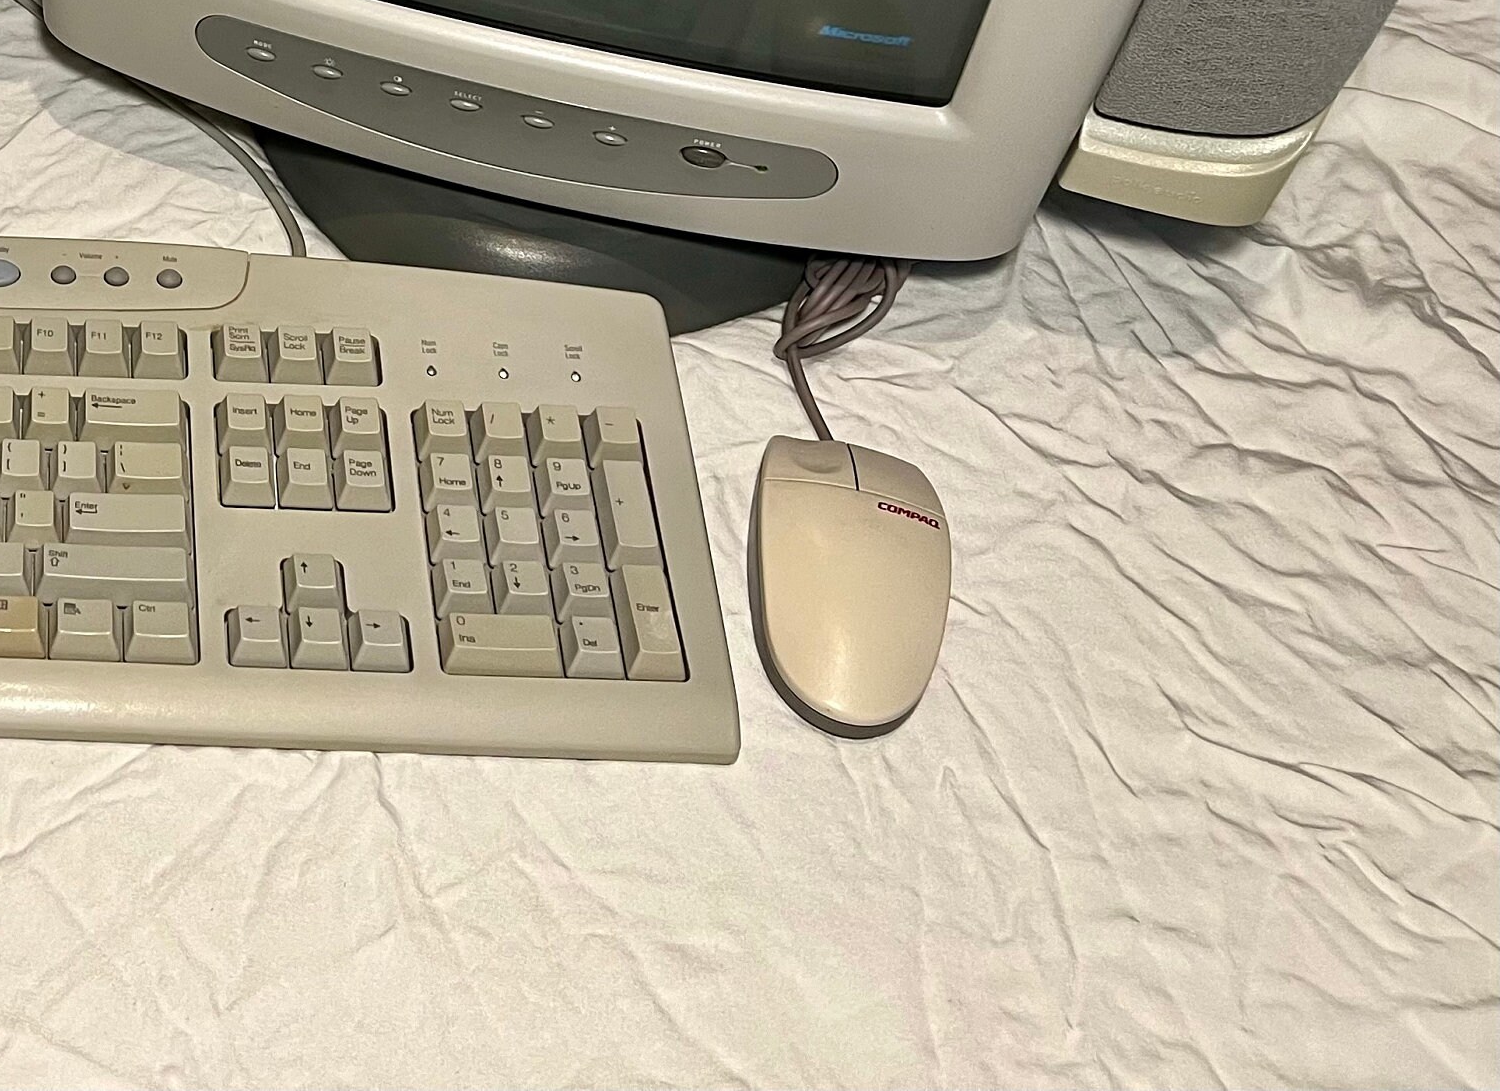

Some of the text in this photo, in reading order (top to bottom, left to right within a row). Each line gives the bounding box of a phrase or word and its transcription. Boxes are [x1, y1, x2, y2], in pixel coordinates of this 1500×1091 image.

[283, 333, 308, 341] Scroll
[338, 336, 366, 345] Pause
[284, 342, 305, 350] Lock
[339, 346, 365, 354] Break
[91, 394, 136, 405] Backspace
[232, 406, 257, 415] Insert
[290, 408, 317, 417] Home
[345, 406, 368, 416] Page
[432, 409, 453, 417] Num
[346, 416, 359, 425] Up
[432, 416, 455, 425] Lock
[293, 462, 311, 470] End
[349, 459, 372, 468] Page
[349, 468, 377, 477] Down
[439, 478, 467, 486] Home
[556, 481, 582, 491] PgUp
[74, 501, 98, 510] Enter
[877, 501, 941, 530] COMPAQ
[452, 580, 471, 588] End
[574, 583, 601, 593] PgDn
[138, 604, 156, 613] Ctrl
[582, 639, 598, 647] Del
